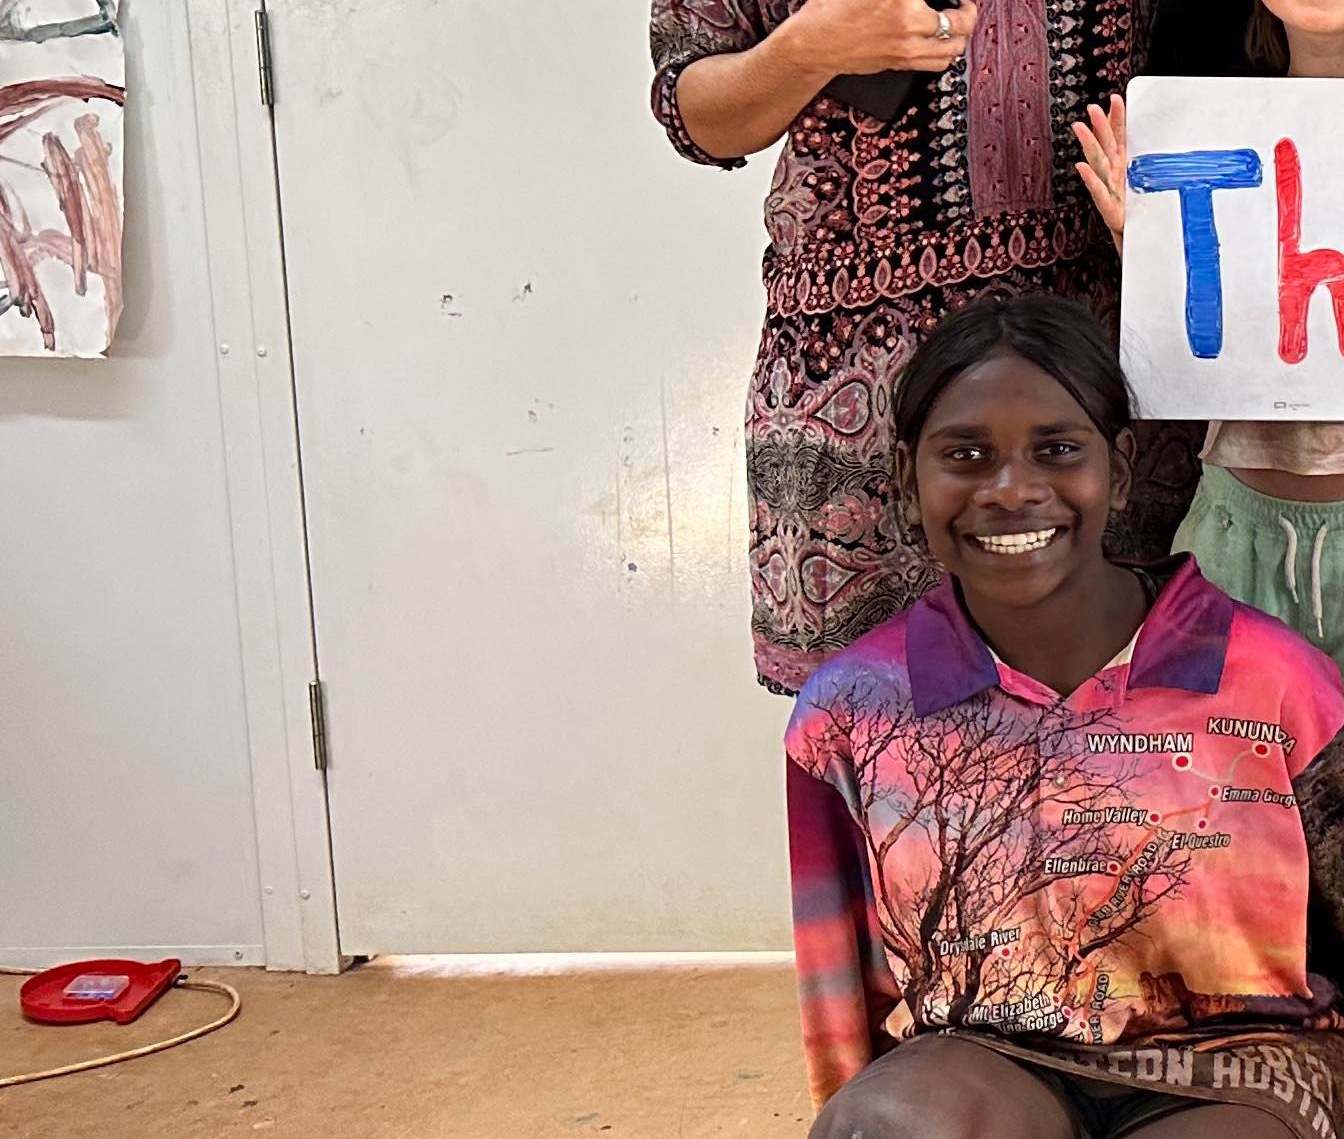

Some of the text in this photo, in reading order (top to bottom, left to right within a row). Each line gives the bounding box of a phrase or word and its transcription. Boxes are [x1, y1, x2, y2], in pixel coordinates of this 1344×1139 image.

[1087, 732, 1194, 753] WYNDHAM
[1221, 785, 1259, 803] Emma
[1063, 807, 1148, 826] Home Valley
[1171, 832, 1232, 851] El Questro
[1044, 857, 1108, 875] Ellenbrae
[1112, 874, 1134, 909] RIVER
[1131, 842, 1159, 876] ROAD
[990, 927, 1021, 948] River
[991, 992, 1051, 1020] Elizabeth
[1089, 973, 1110, 1045] IVER ROAD
[1025, 1010, 1065, 1033] Gorge
